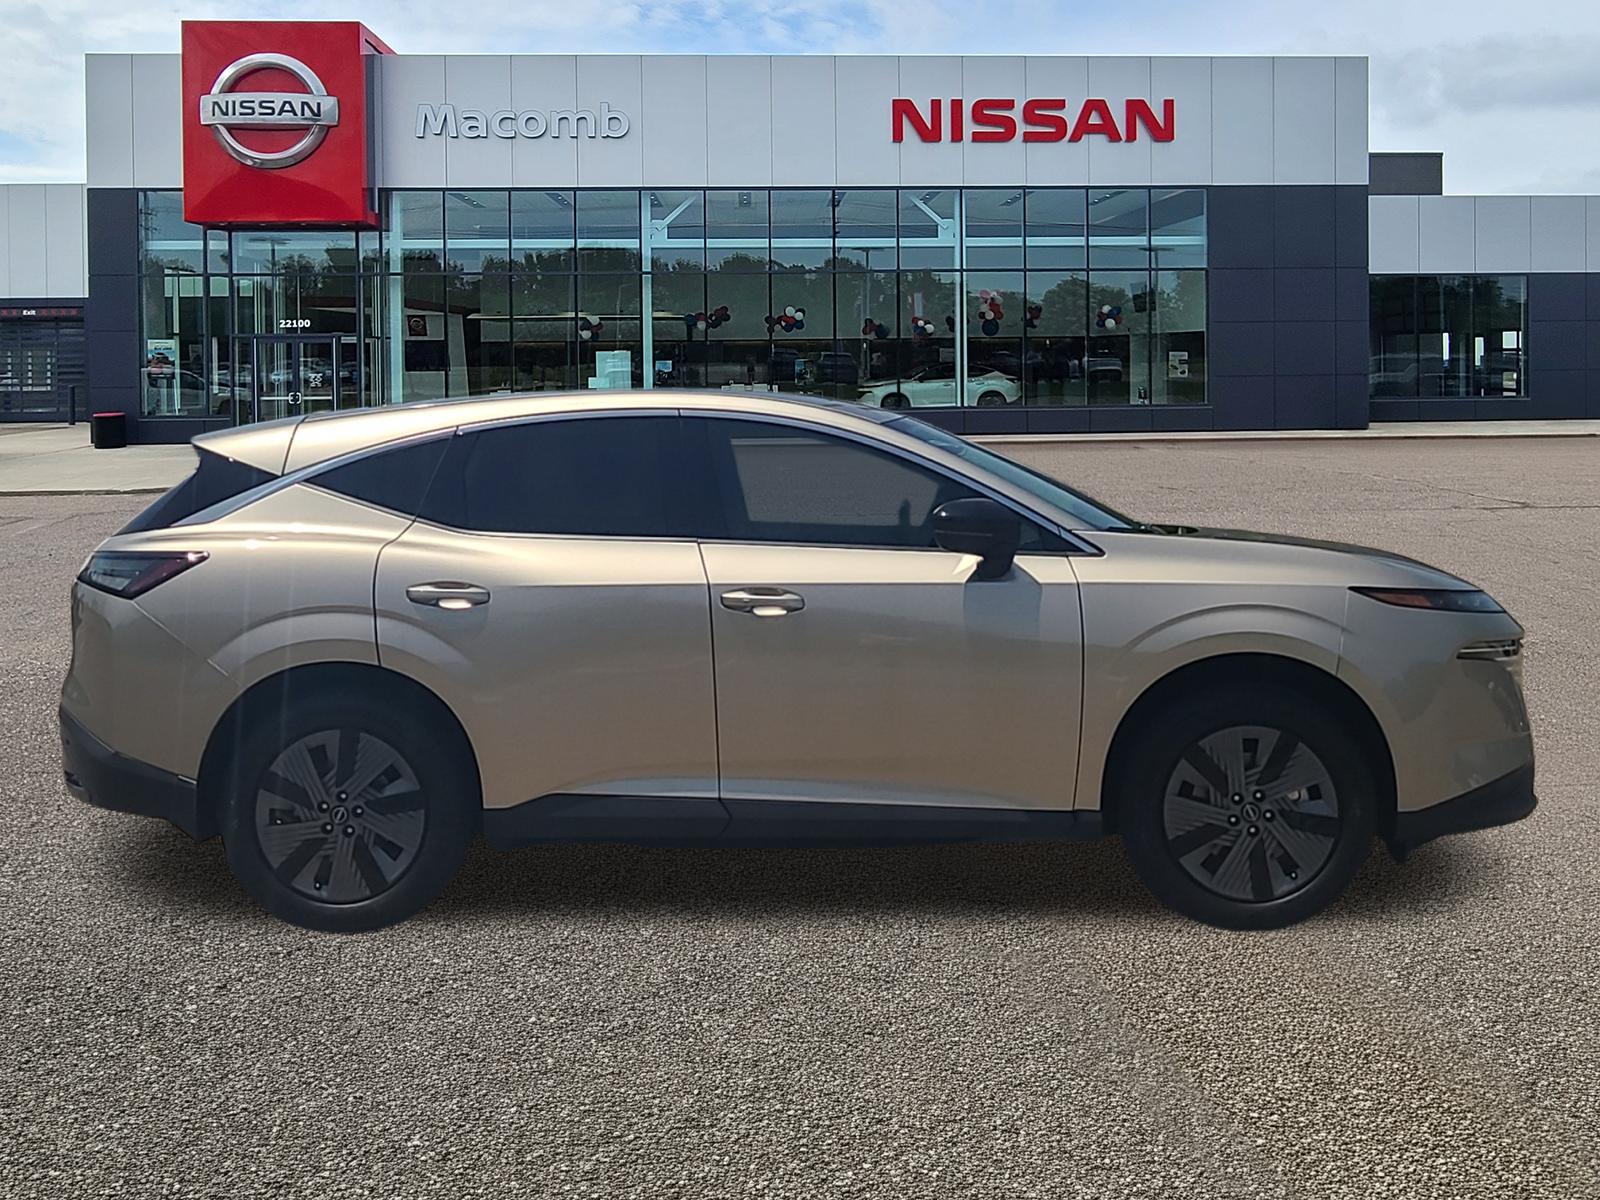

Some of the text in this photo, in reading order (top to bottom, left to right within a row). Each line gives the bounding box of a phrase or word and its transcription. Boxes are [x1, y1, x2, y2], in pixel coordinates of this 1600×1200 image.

[213, 100, 321, 117] NISSAN
[415, 102, 630, 139] Macomb
[892, 98, 1175, 143] NISSAN
[280, 320, 310, 328] 22100
